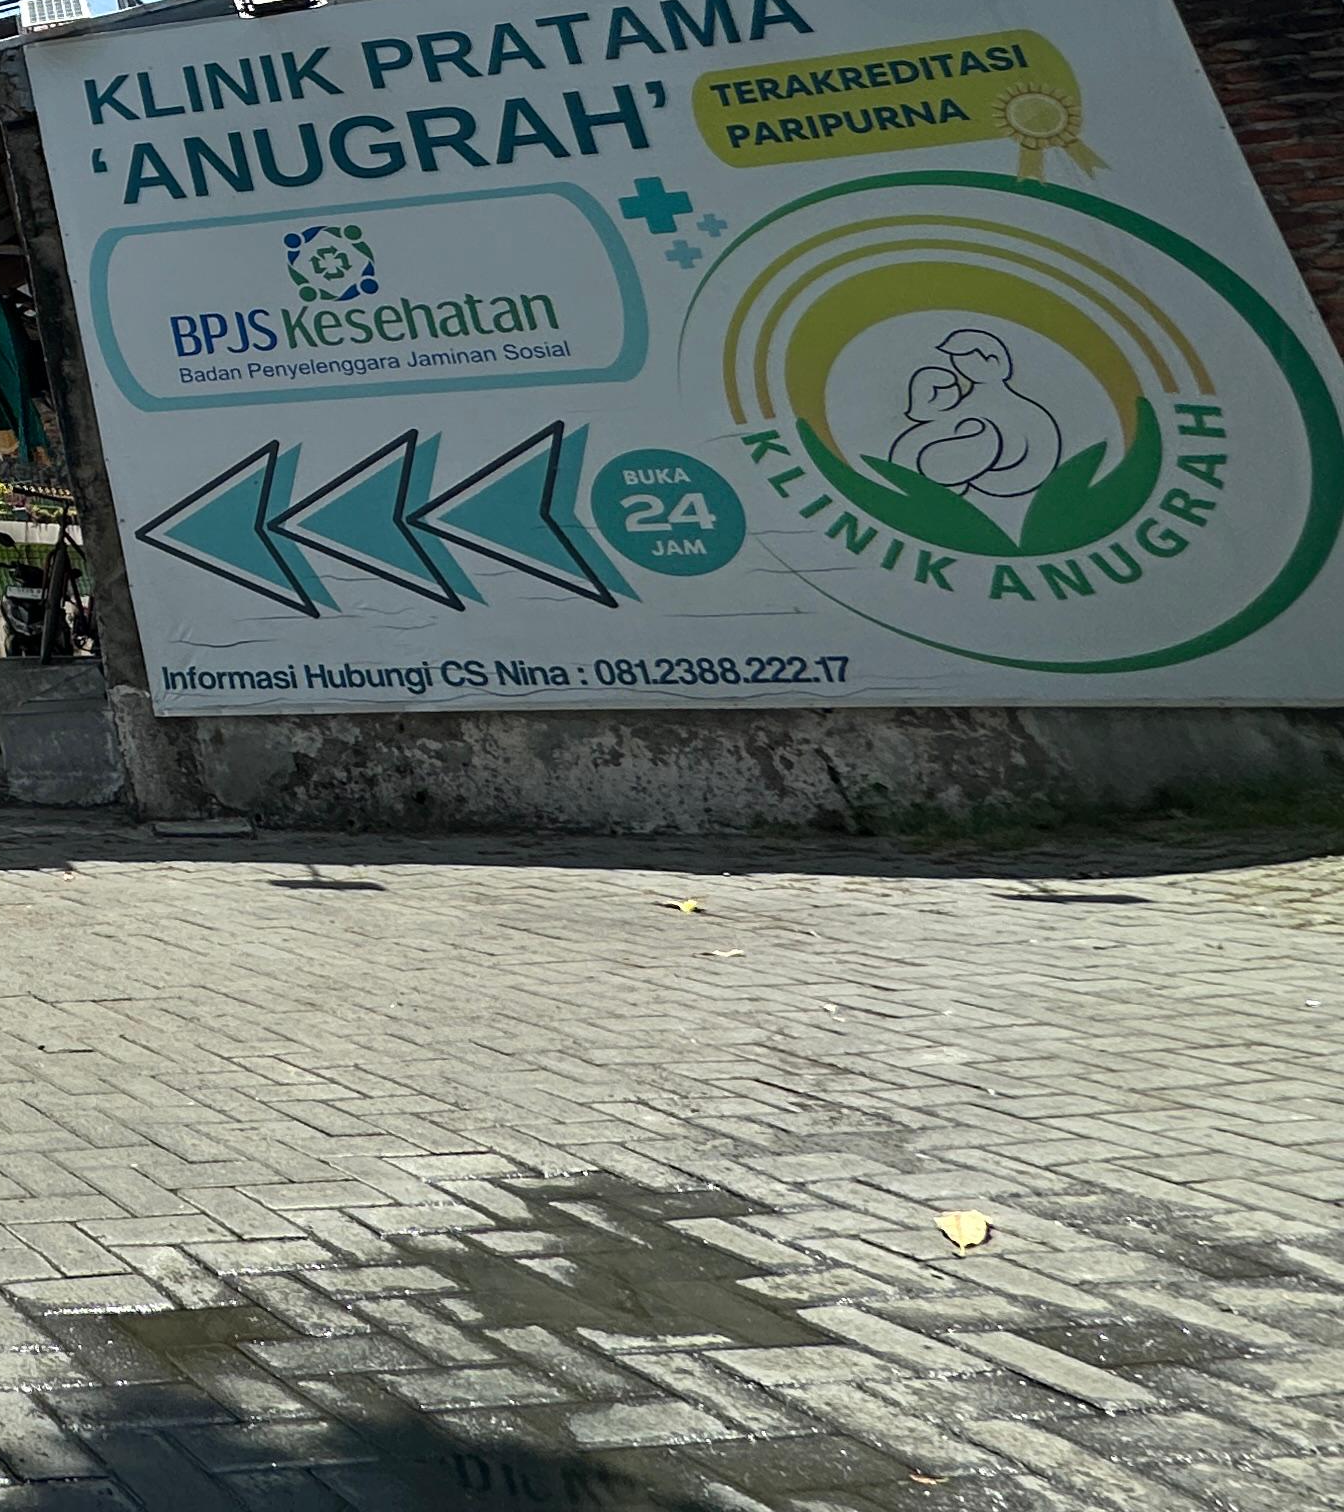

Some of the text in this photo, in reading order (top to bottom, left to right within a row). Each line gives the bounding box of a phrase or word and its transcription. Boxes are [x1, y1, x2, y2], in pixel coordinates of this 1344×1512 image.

[84, 46, 345, 124] KLINIK
[709, 44, 1029, 107] TERAKREDITASI
[726, 98, 970, 148] PARIPURNA
[170, 293, 560, 357] BPJS Kesehatan
[179, 340, 571, 384] Badan Penyelenggara Jaminan Sosial
[622, 468, 691, 485] BUKA
[619, 492, 717, 532] 24
[740, 404, 1229, 601] KLINIK ANUGRAH
[651, 539, 707, 556] JAM
[161, 664, 298, 690] Informasi
[303, 661, 434, 695] Hubungi
[440, 660, 489, 687] CS
[494, 660, 570, 686] Nina
[594, 656, 849, 686] 081.2388.222.17
